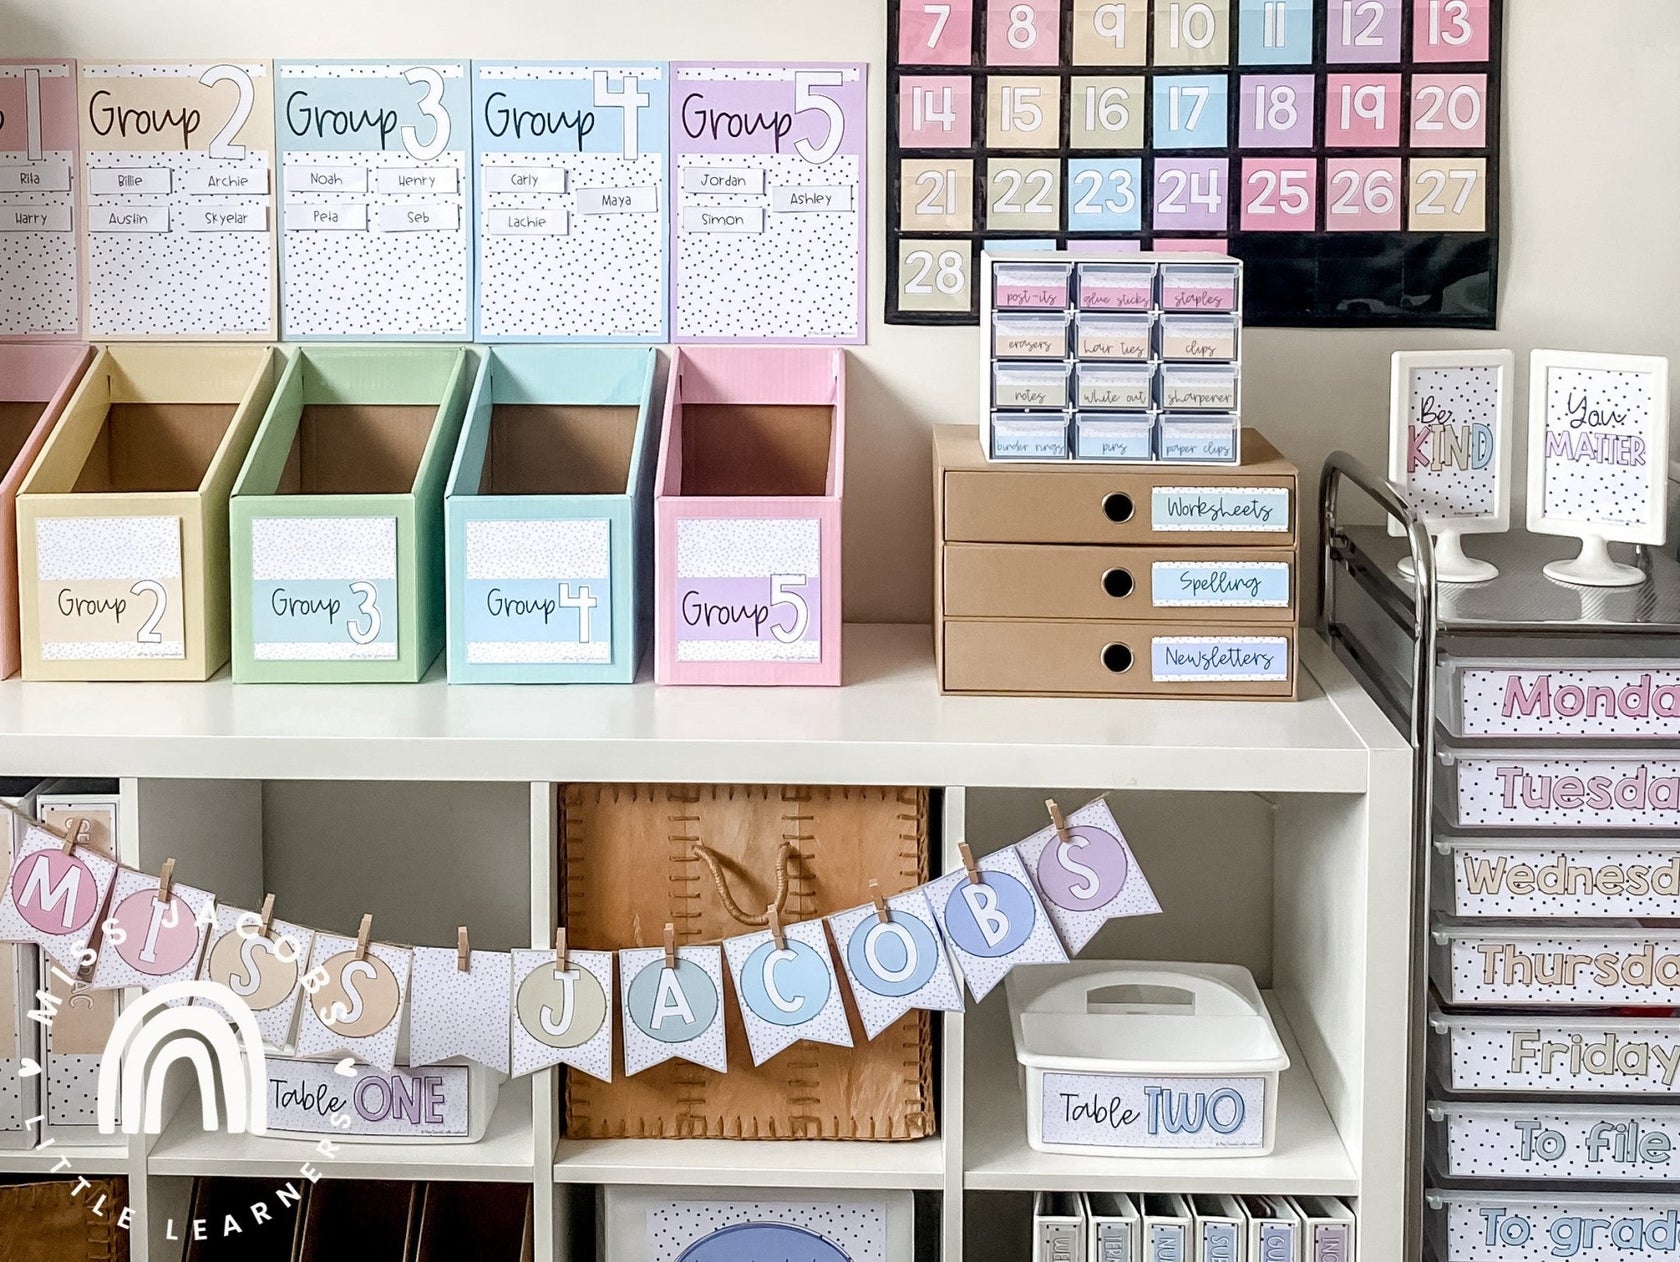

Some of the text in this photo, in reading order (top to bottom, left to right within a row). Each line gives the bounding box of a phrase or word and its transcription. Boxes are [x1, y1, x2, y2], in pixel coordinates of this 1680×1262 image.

[923, 4, 951, 49] 7
[1007, 4, 1037, 49] 8
[1093, 3, 1126, 49] 9
[1168, 2, 1216, 49] 10
[1263, 2, 1285, 47] 11
[1341, 0, 1385, 46] 12
[1427, 0, 1472, 46] 13
[89, 64, 255, 160] Group 2
[286, 66, 451, 161] Group 3
[484, 70, 650, 160] Group 4
[682, 71, 845, 165] Group 5
[912, 86, 956, 132] 14
[1001, 86, 1043, 132] 15
[1085, 86, 1130, 132] 16
[1168, 86, 1210, 131] 17
[1254, 84, 1298, 131] 18
[1340, 84, 1385, 130] 19
[1414, 84, 1481, 131] 20
[118, 173, 143, 186] Billie
[208, 173, 249, 187] Archie
[310, 172, 343, 185] Noah
[398, 174, 436, 188] Henry
[511, 173, 539, 187] Carly
[602, 193, 632, 208] Maya
[700, 173, 746, 186] Jordan
[790, 192, 832, 206] Ashley
[915, 169, 957, 215] 21
[992, 169, 1054, 214] 22
[1074, 168, 1135, 214] 23
[1157, 168, 1222, 214] 24
[1247, 169, 1310, 215] 25
[1331, 168, 1394, 214] 26
[1414, 170, 1478, 214] 27
[15, 211, 48, 225] Harry
[109, 212, 148, 225] Austin
[205, 211, 248, 225] Skyelar
[407, 211, 430, 223] Seb
[508, 215, 547, 228] Lachie
[701, 214, 744, 226] Simon
[904, 250, 964, 295] 28
[1006, 290, 1057, 305] post-its
[1084, 292, 1150, 308] glue sticks
[1174, 291, 1223, 307] staples
[1009, 339, 1052, 352] erasers
[1120, 342, 1145, 358] ties
[1185, 340, 1216, 357] clips
[1015, 388, 1046, 404] notes
[1083, 390, 1147, 405] white out
[1168, 390, 1233, 406] sharpener
[1420, 395, 1453, 425] Be
[1567, 392, 1627, 429] You
[1102, 441, 1128, 455] pins
[1166, 440, 1230, 457] paper clips
[1407, 423, 1494, 473] KIND
[1545, 430, 1647, 467] MATTER
[1167, 497, 1273, 521] Worksheets
[1180, 571, 1262, 597] Spelling
[58, 579, 168, 643] Group 2
[271, 580, 382, 645] Group 3
[487, 582, 597, 643] Group 4
[682, 574, 809, 643] Group 5
[1165, 645, 1275, 670] Newsletters
[1511, 1031, 1680, 1086] Friday
[270, 1074, 445, 1125] Table ONE
[1060, 1086, 1246, 1135] Table TWO
[1514, 1120, 1671, 1163] To file
[1479, 1208, 1680, 1257] To grad
